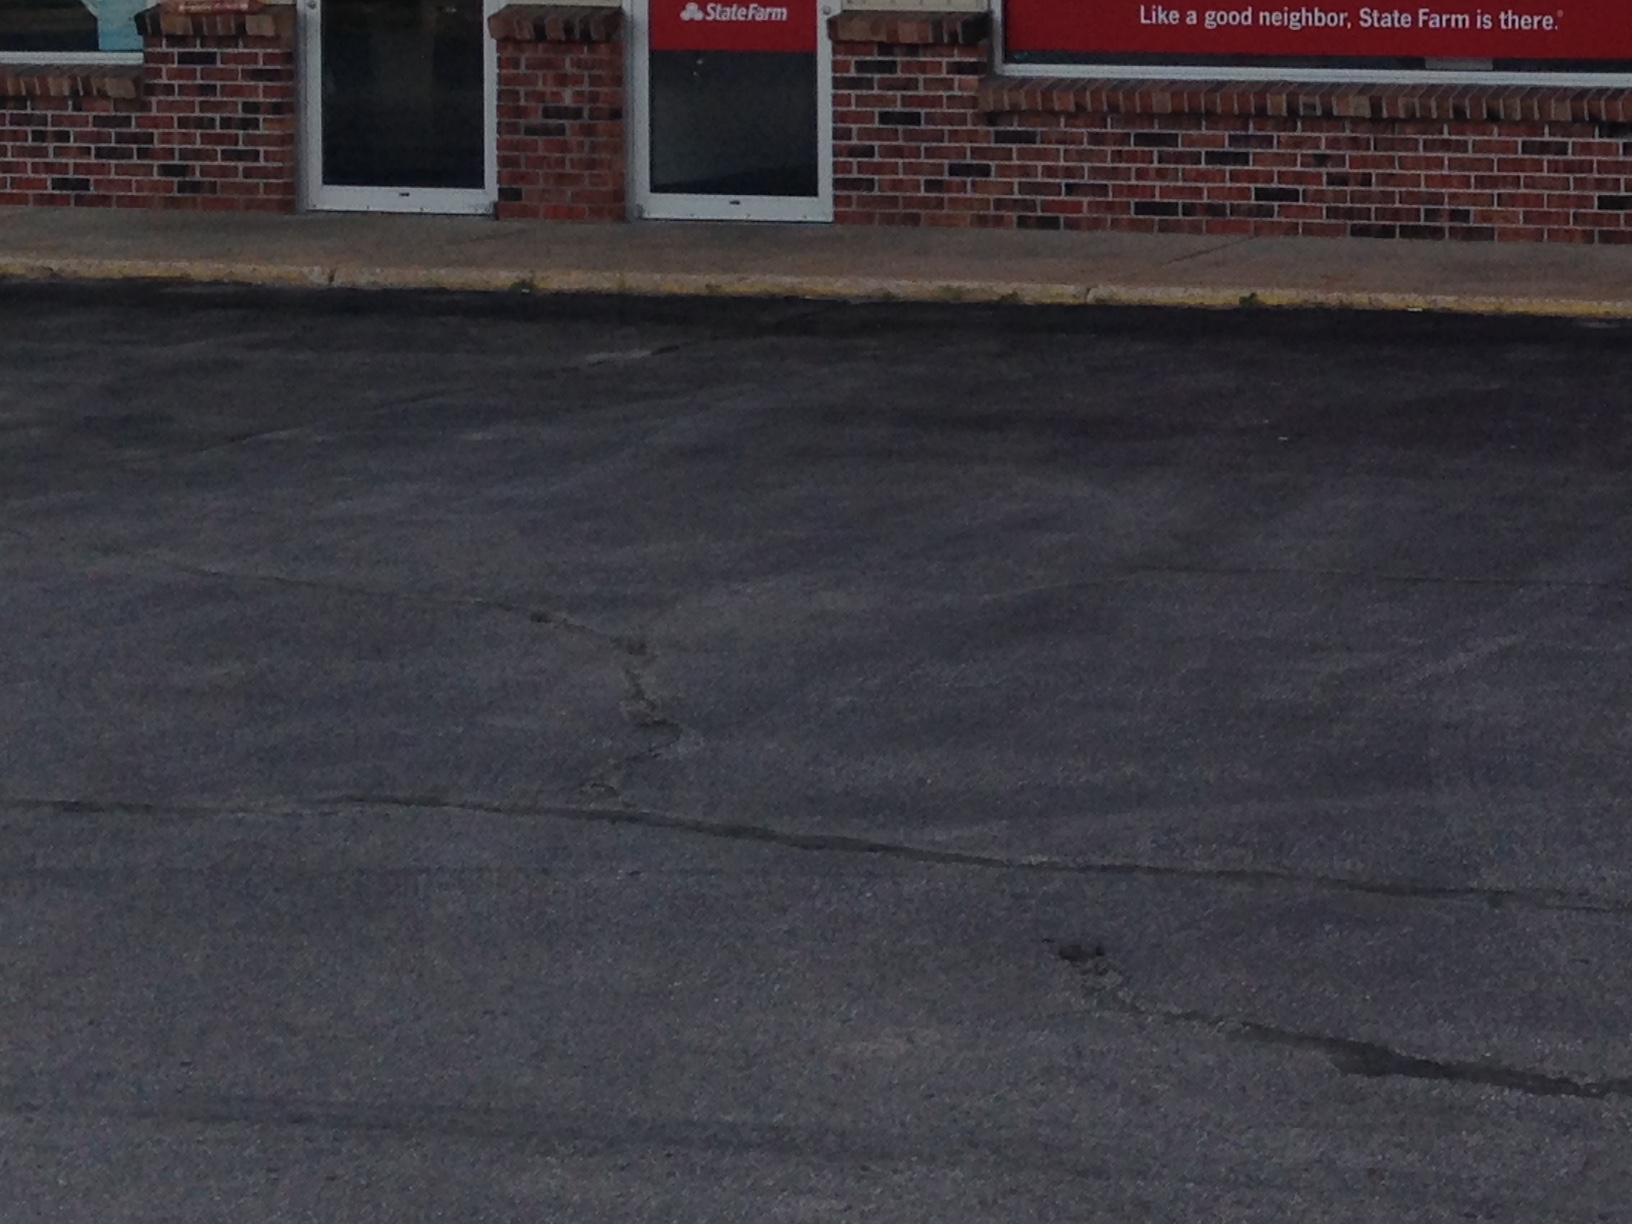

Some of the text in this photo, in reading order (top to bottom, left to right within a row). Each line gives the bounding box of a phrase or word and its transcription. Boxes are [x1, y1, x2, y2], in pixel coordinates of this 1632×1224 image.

[1139, 4, 1179, 25] Like
[1185, 10, 1197, 25] a
[1204, 6, 1252, 29] good
[1258, 7, 1352, 30] neighbor,
[1359, 7, 1412, 28] State
[1418, 8, 1470, 28] Farm
[1476, 9, 1493, 29] is
